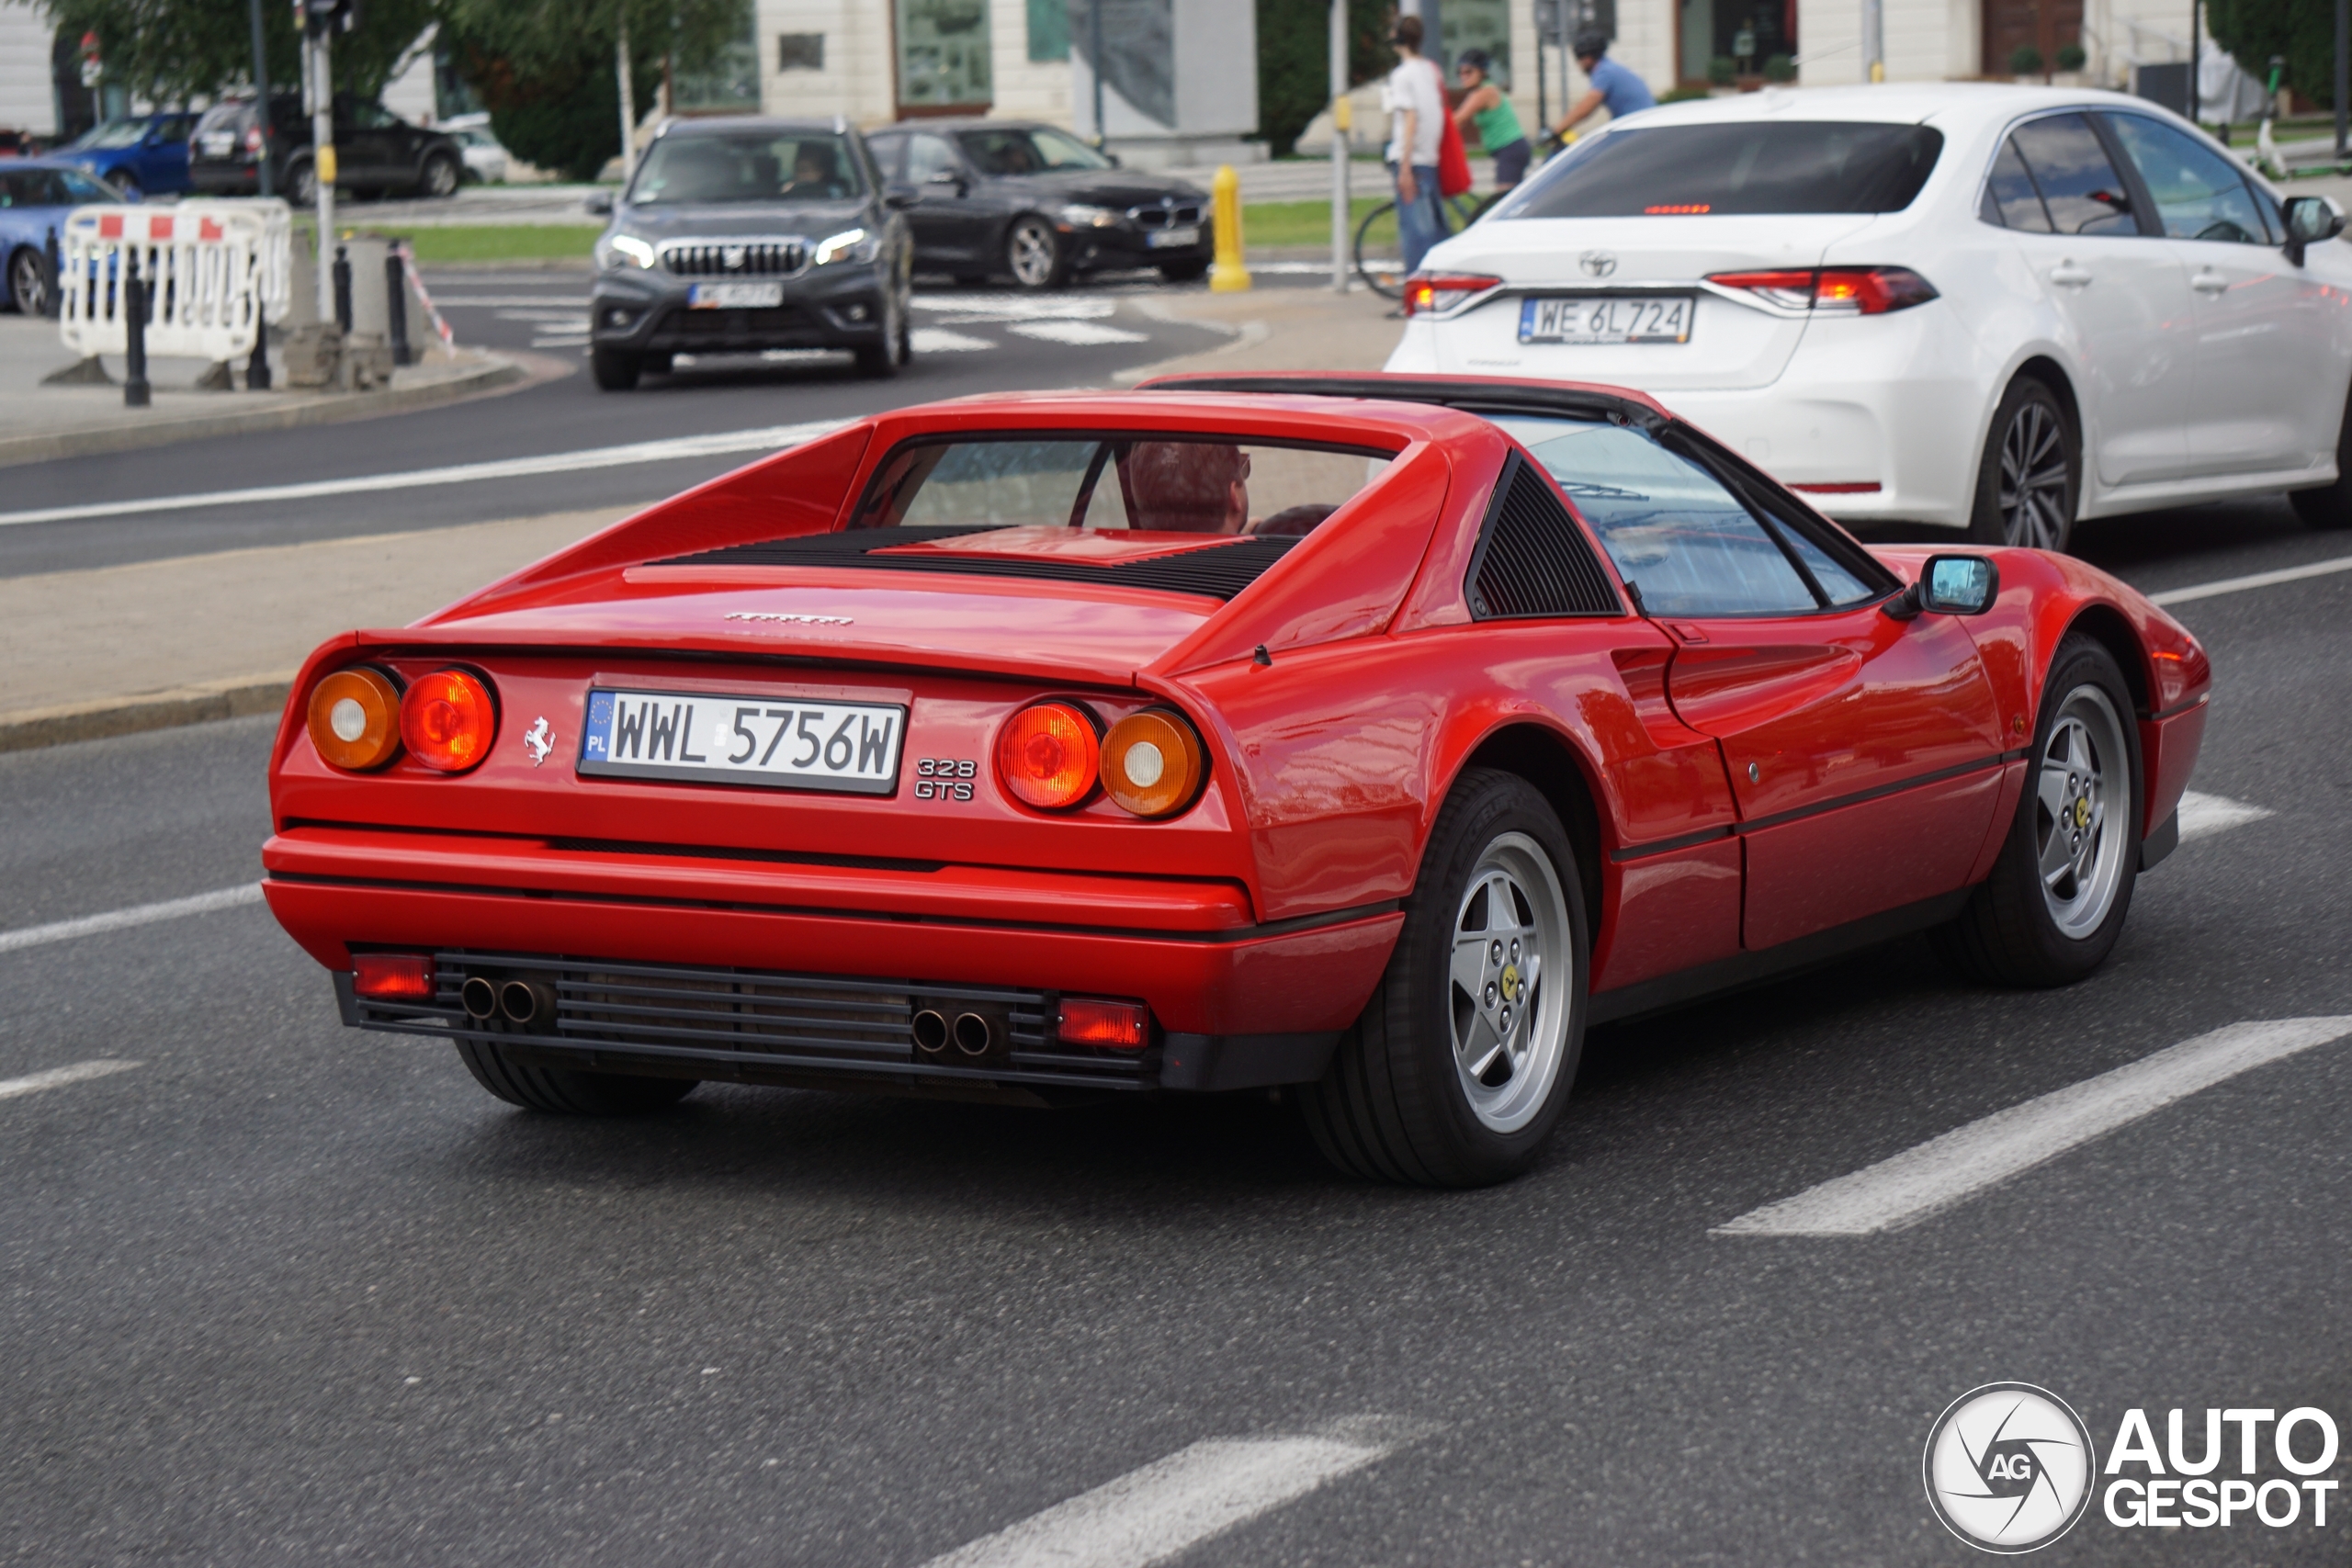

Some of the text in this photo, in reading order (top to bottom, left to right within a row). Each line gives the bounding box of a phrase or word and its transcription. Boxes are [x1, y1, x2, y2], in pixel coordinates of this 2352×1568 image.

[1540, 302, 1683, 333] WE 6L724
[587, 736, 606, 753] PL
[615, 701, 893, 774] WWL 5756W
[918, 758, 977, 778] 328
[914, 780, 974, 800] GTS
